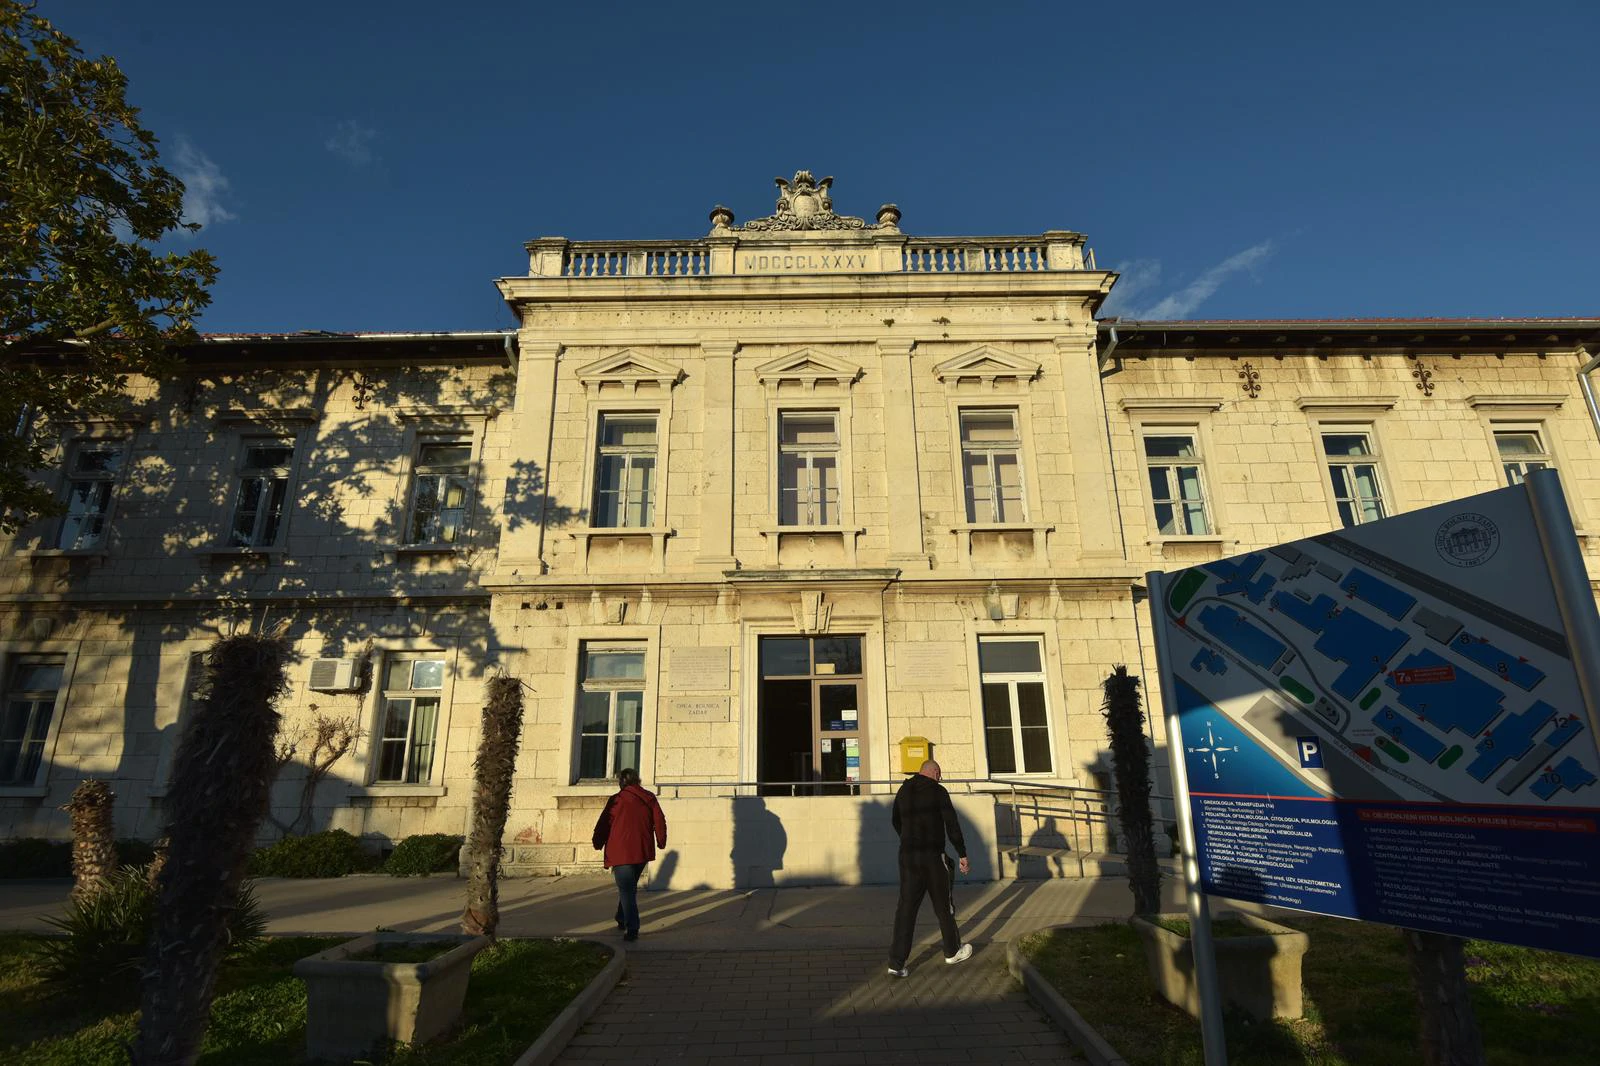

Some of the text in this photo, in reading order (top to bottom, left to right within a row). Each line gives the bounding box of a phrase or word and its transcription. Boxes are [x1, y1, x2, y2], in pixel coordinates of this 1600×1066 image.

[744, 255, 867, 270] MDCCCLXXXV
[1551, 717, 1569, 728] 12
[1302, 742, 1318, 762] P
[1540, 773, 1561, 784] 10
